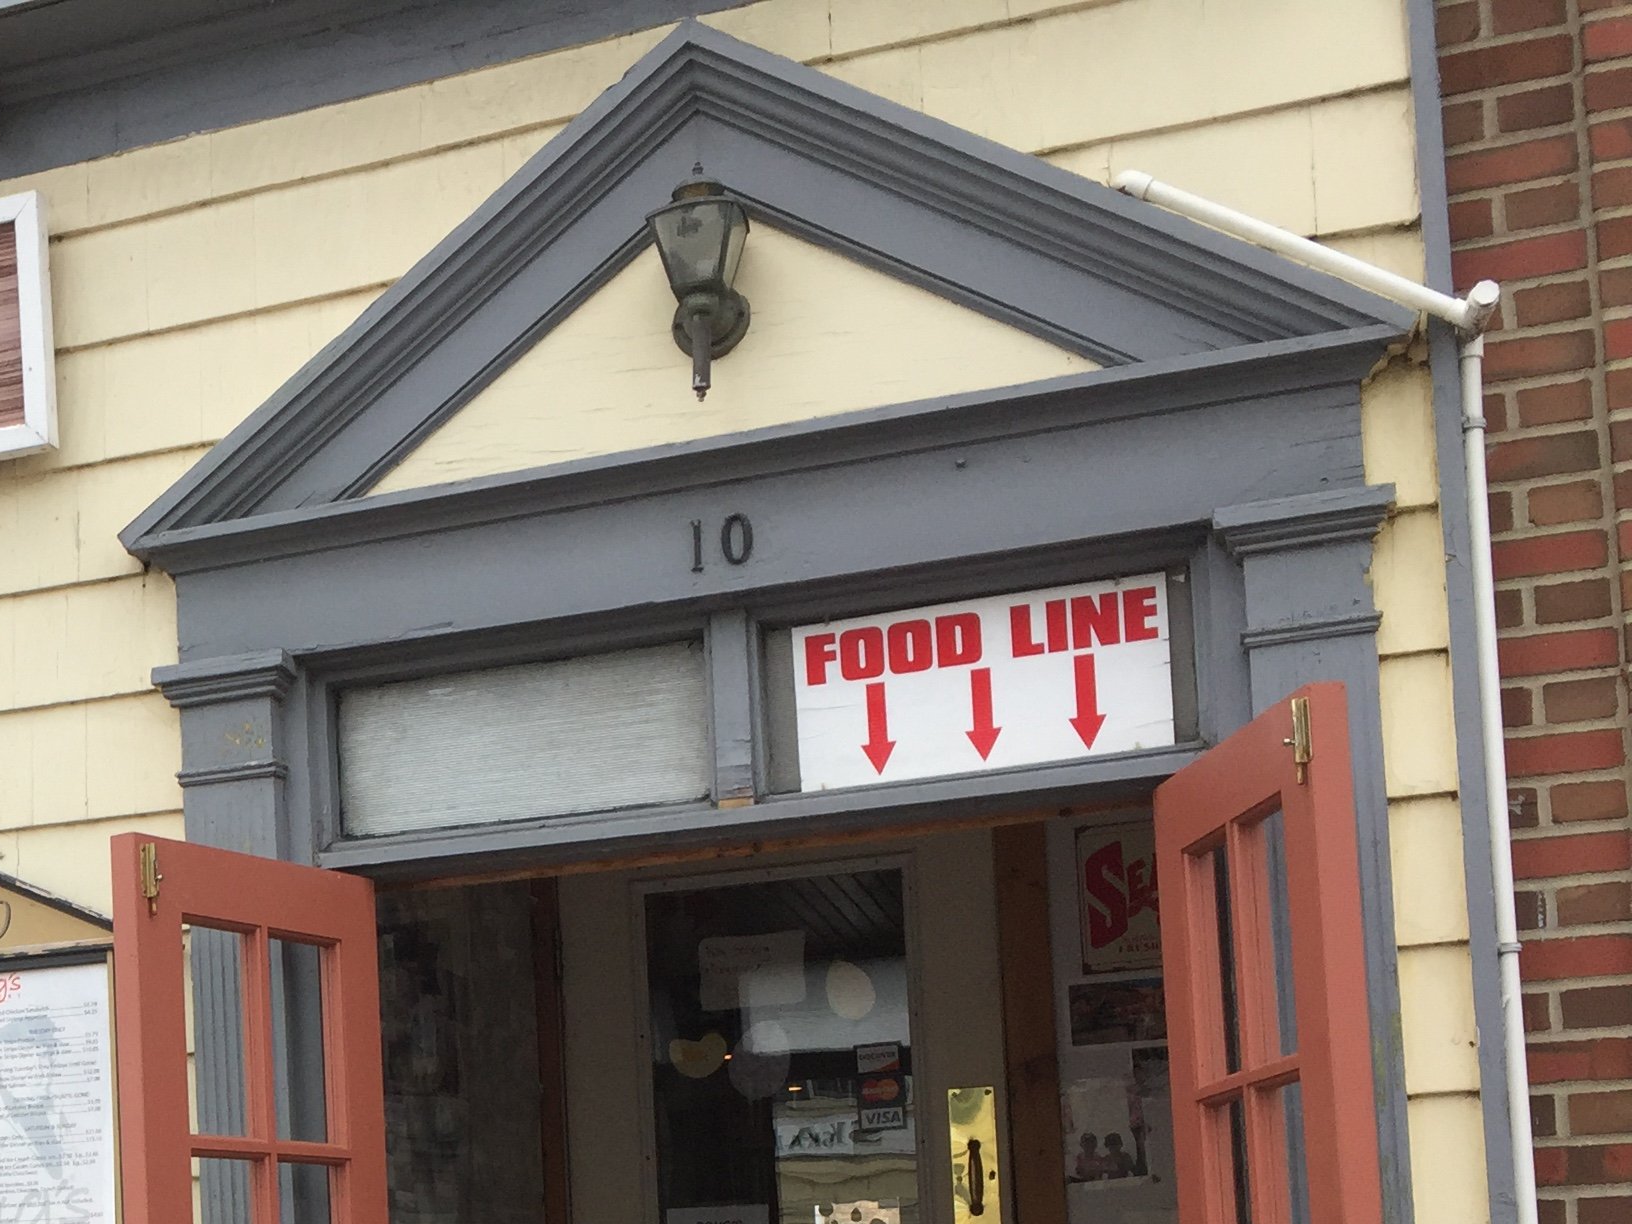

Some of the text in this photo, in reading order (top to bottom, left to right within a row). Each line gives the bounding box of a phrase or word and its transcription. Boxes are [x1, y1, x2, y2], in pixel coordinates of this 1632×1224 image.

[689, 512, 754, 573] 10
[804, 585, 1159, 686] FOOD LINE
[864, 1111, 902, 1125] VISA
